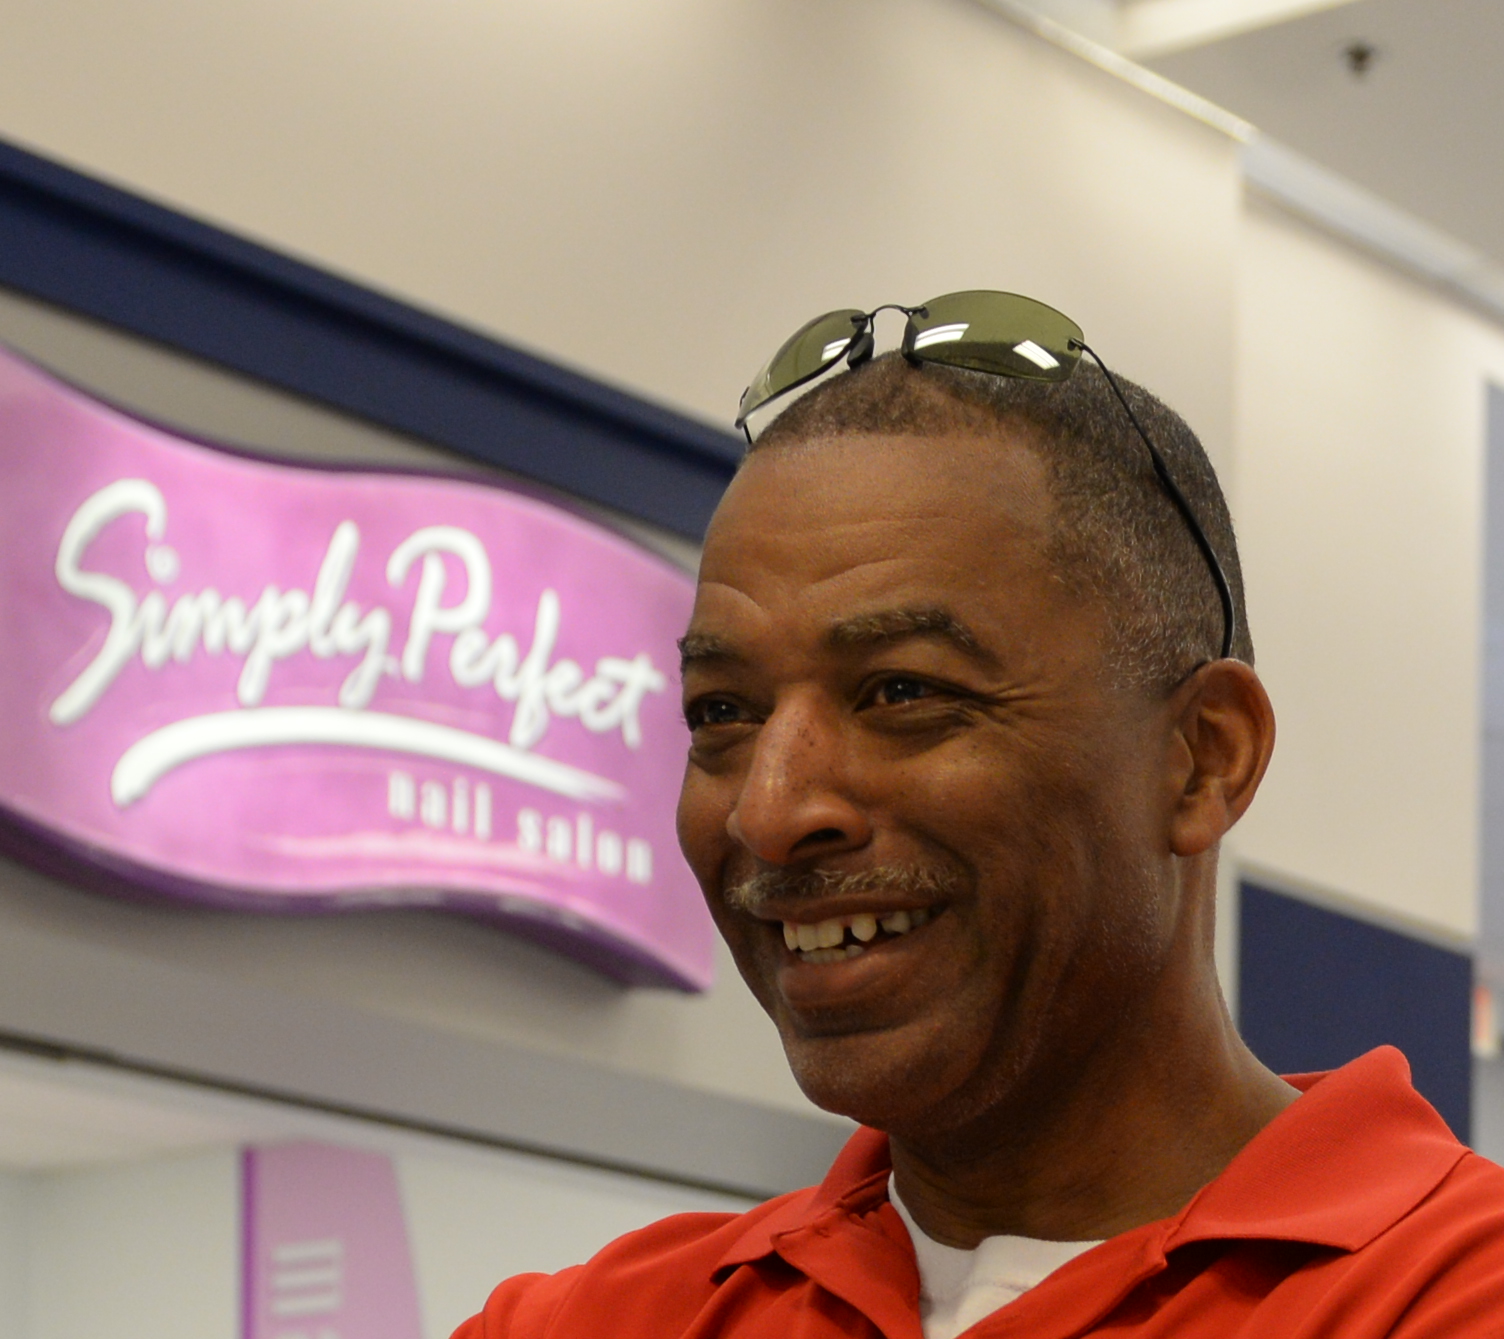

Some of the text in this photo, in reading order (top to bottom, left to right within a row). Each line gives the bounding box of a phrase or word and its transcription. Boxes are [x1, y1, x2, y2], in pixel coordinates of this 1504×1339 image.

[49, 476, 667, 750] Simply Perfect
[387, 769, 654, 885] nail salon
